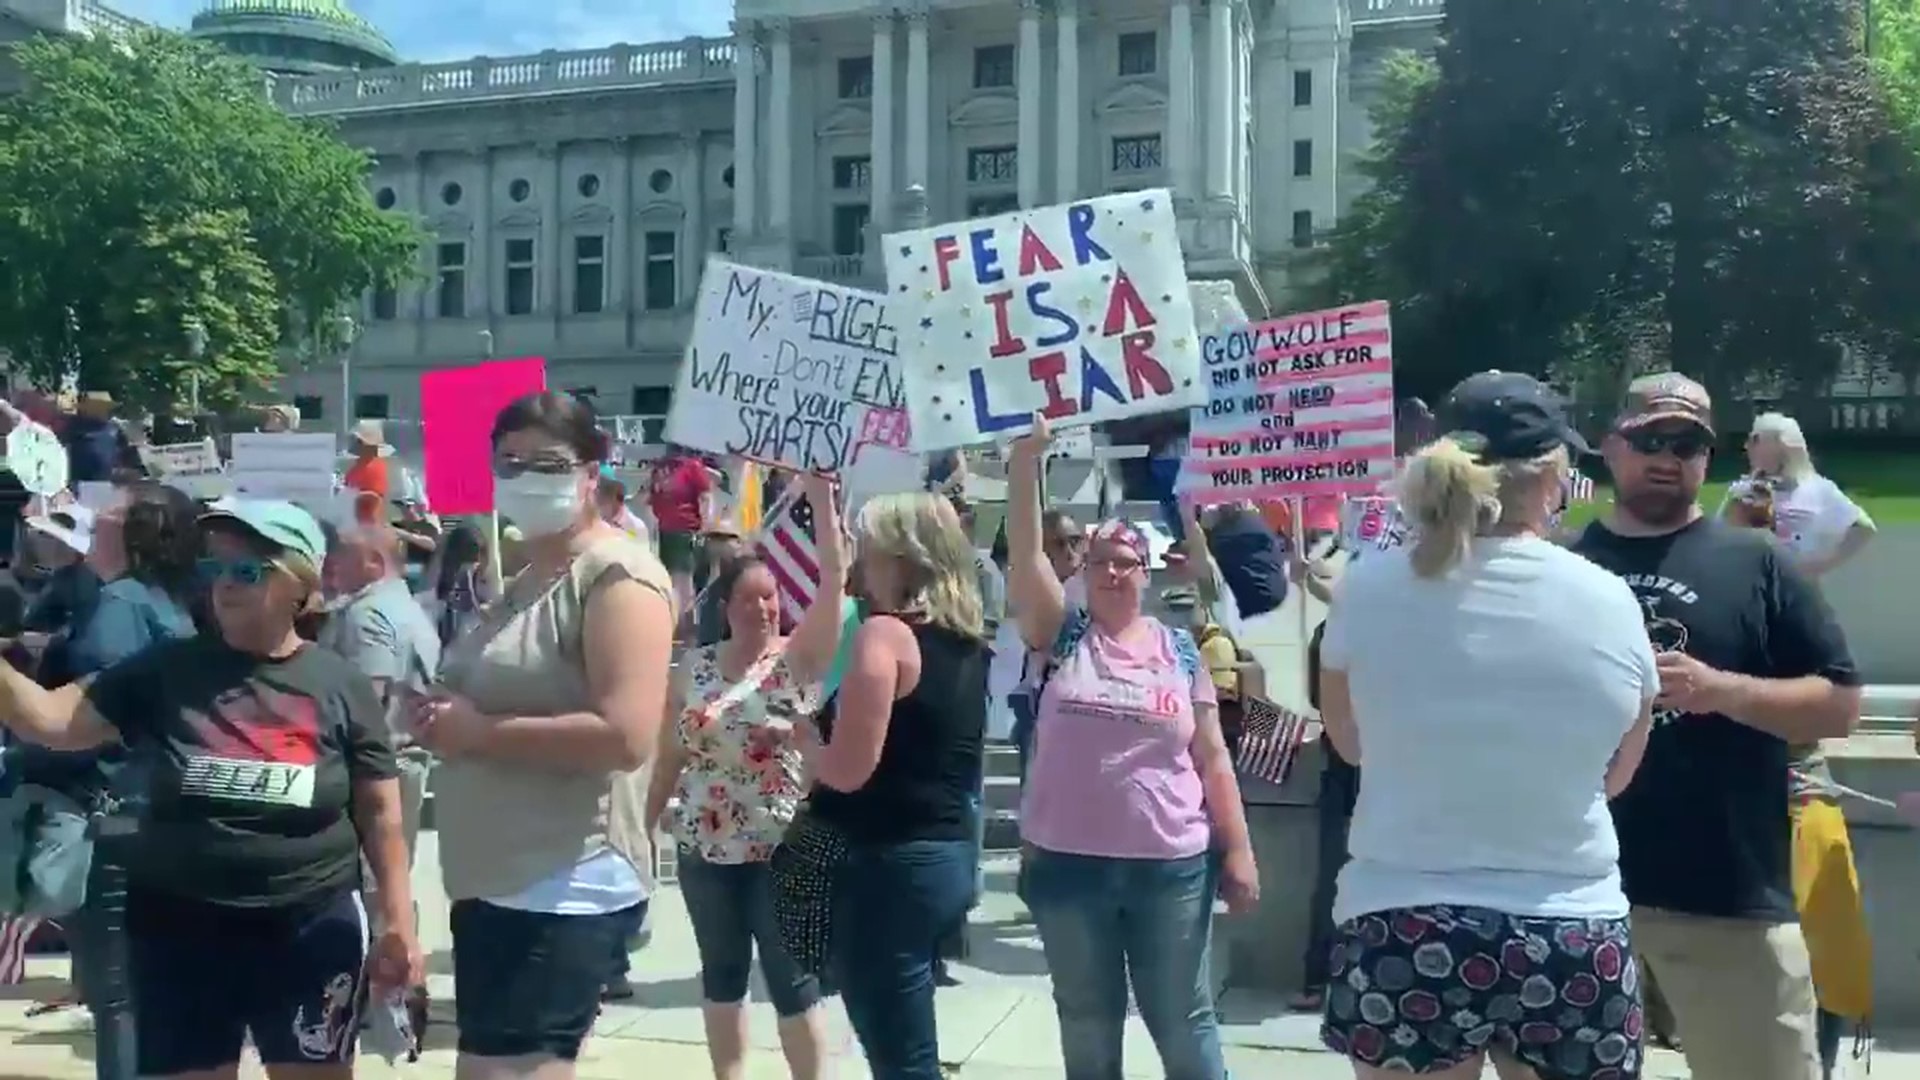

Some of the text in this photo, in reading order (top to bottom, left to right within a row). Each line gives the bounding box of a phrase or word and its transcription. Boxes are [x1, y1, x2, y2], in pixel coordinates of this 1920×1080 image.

[934, 203, 1113, 292] FEAR
[721, 271, 898, 356] My RIGH
[984, 261, 1158, 359] IS A
[1203, 311, 1361, 365] GOV WOLF
[691, 347, 780, 408] Where
[792, 387, 852, 422] your
[773, 339, 906, 408] Don't EN
[968, 332, 1175, 434] LIAR
[1246, 359, 1279, 379] NOT
[1290, 352, 1327, 374] ASK
[1335, 345, 1373, 366] FOR
[1212, 398, 1235, 416] DO
[1243, 393, 1276, 414] NOT
[1289, 386, 1335, 410] NEED
[1211, 459, 1369, 488] YOUR PROTECTION
[1219, 441, 1242, 456] DO
[1250, 433, 1284, 453] NOT
